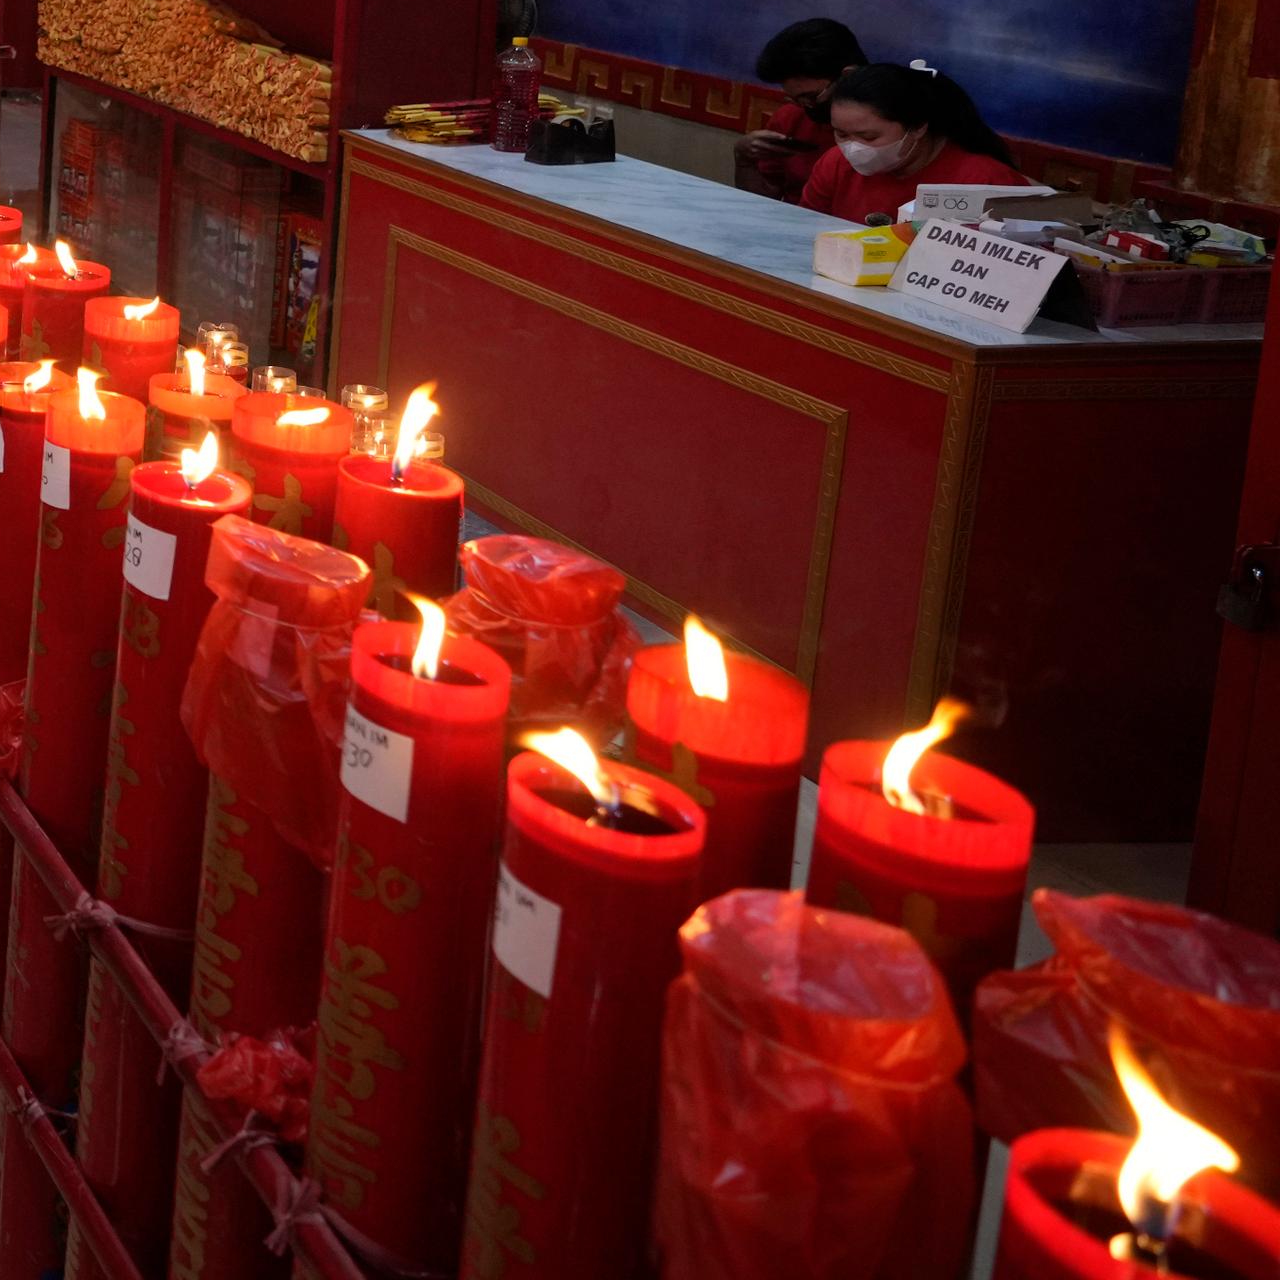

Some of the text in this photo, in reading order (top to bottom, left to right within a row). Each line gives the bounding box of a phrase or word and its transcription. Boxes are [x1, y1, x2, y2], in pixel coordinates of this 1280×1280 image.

[926, 225, 1046, 271] DANA IMLEK
[950, 258, 990, 281] DAN
[906, 271, 1010, 314] CAP GO MEH
